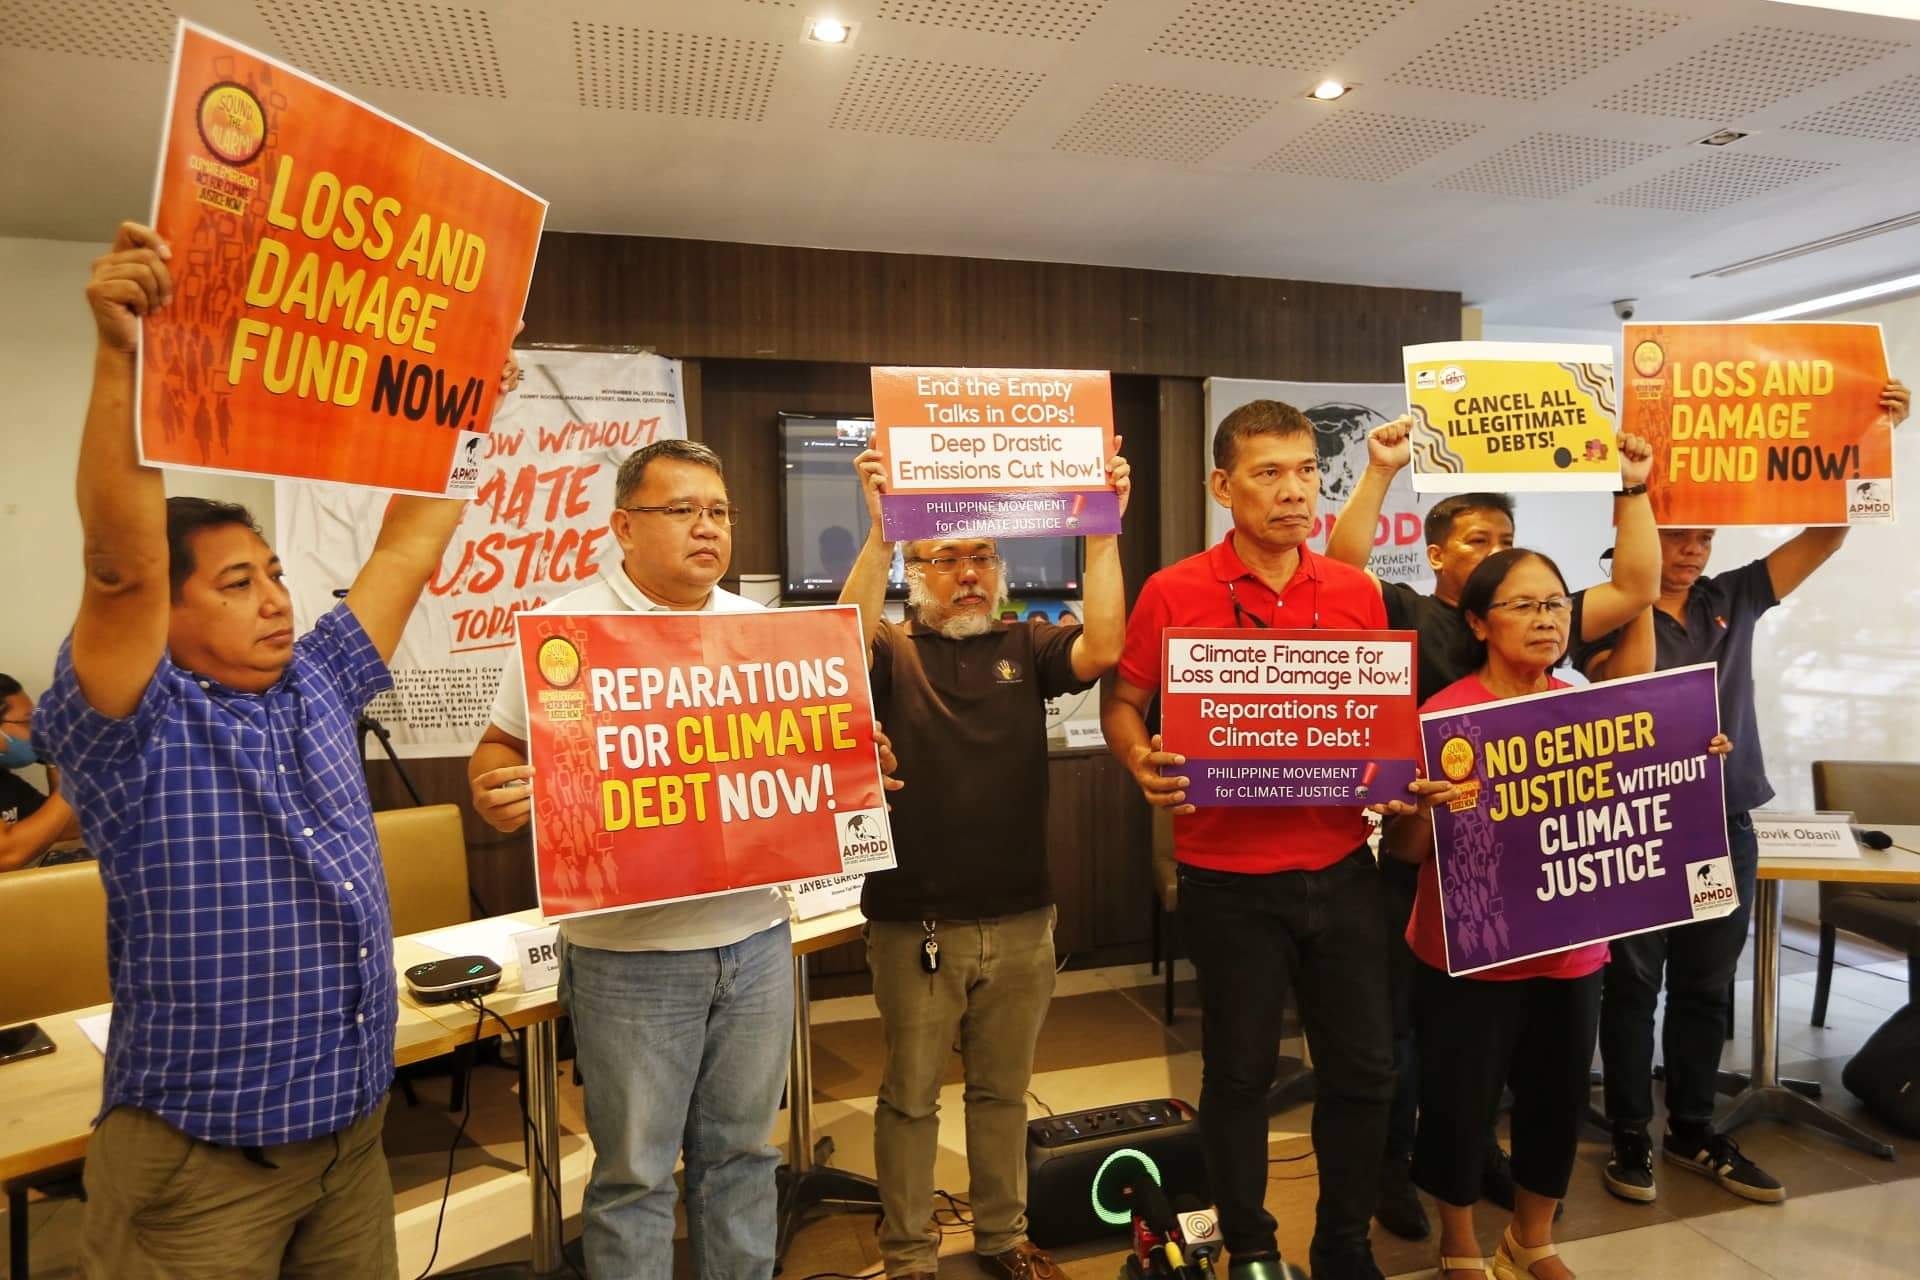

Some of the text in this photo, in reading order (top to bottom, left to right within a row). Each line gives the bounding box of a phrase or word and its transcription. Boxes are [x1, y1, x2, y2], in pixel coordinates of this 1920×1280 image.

[266, 154, 485, 292] LOSS AND
[244, 239, 449, 353] DAMAGE
[228, 318, 484, 431] FUND NOW!
[1672, 361, 1754, 398] LOSS
[1762, 359, 1834, 396] AND
[917, 376, 1073, 401] End the Empty
[925, 404, 1075, 423] Talks in COPs!
[1454, 389, 1577, 417] CANCEL ALL
[1447, 408, 1587, 438] ILLEGITIMATE
[1671, 402, 1811, 441] DAMAGE
[538, 417, 661, 453] WITHOUT
[931, 433, 1062, 455] Deep Drastic
[1486, 431, 1555, 455] DEBTS!
[899, 457, 1101, 480] Emissions Cut Now!
[1669, 444, 1861, 483] FUND NOW!
[926, 499, 1067, 513] PHILIPPINE MOVEMENT
[1849, 503, 1890, 513] APMDD
[935, 518, 1061, 532] for CLIMATE JUSTICE
[428, 526, 610, 597] USTICE
[1190, 644, 1383, 665] Climate Finance for
[590, 656, 849, 711] REPARATIONS
[1170, 665, 1409, 689] Loss and Damage Now!
[1200, 699, 1379, 724] Reparations for
[597, 703, 857, 770] FOR CLIMATE
[1209, 727, 1371, 747] Climate Debt!
[1484, 711, 1655, 778] NO GENDER
[1207, 767, 1357, 779] PHILIPPINE MOVEMENT
[602, 764, 836, 831] DEBT NOW!
[1216, 786, 1349, 798] for CLIMATE JUSTICE
[1490, 755, 1708, 821] JUSTICE WITHOUT
[1539, 794, 1673, 855] CLIMATE
[1794, 828, 1841, 841] Obanil
[843, 840, 888, 857] APMDD
[1536, 840, 1666, 903] JUSTICE
[799, 876, 833, 894] JAYBEE
[1693, 887, 1733, 904] APMDD
